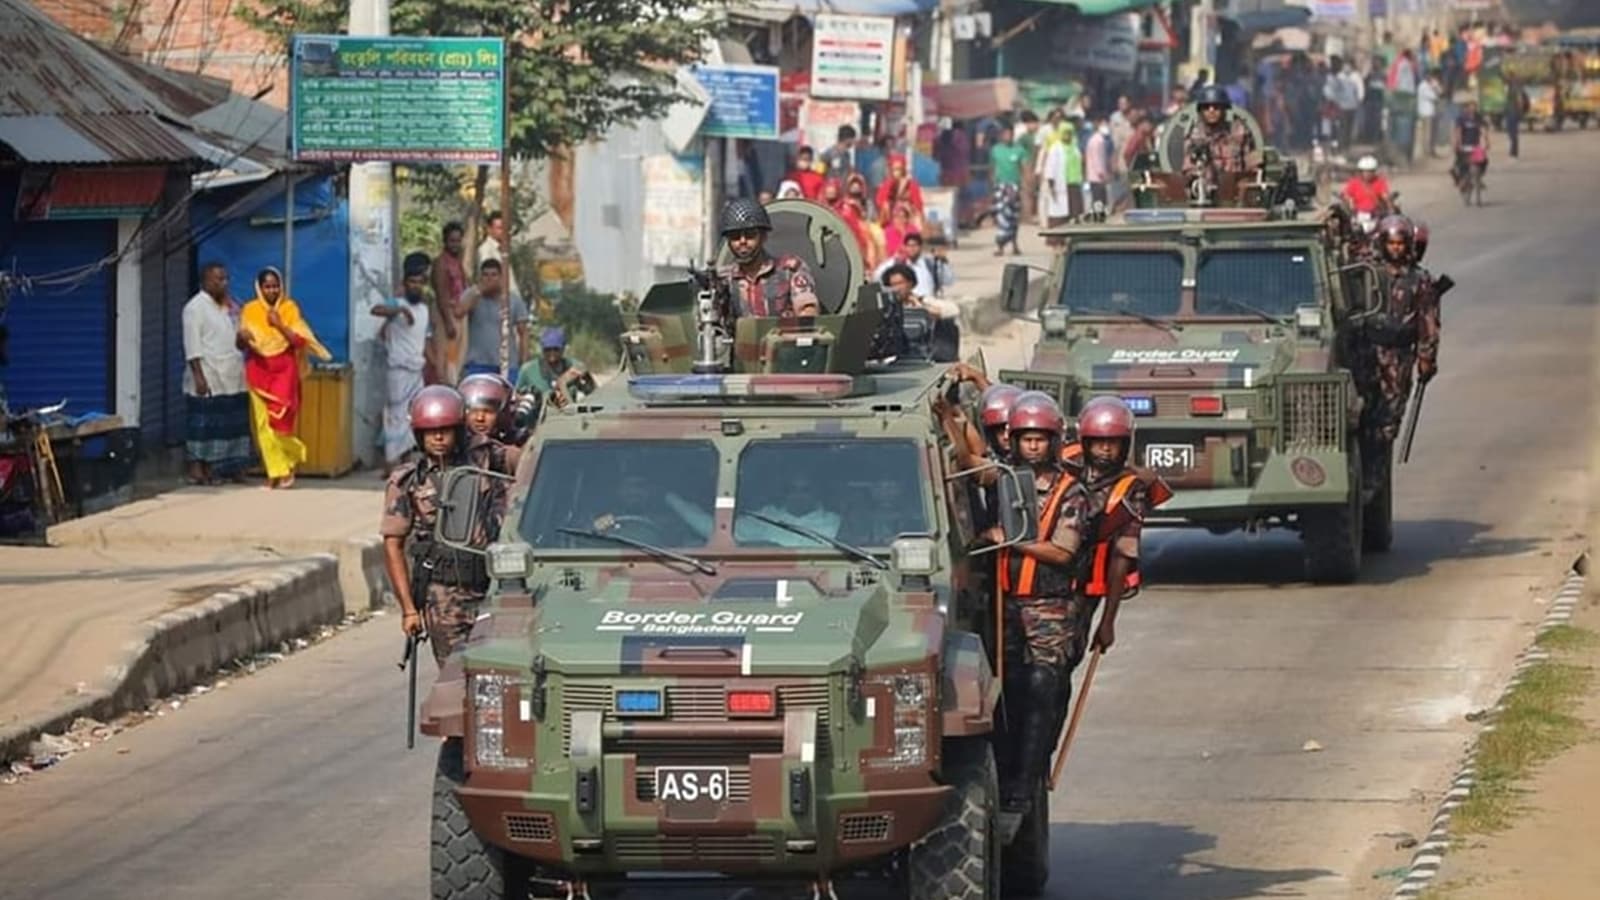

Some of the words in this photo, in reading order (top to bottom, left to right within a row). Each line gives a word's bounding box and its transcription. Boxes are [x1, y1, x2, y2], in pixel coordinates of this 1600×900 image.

[1111, 349, 1178, 359] Border
[1181, 349, 1239, 359] Guard
[1151, 448, 1188, 468] RS-1
[601, 610, 705, 625] Border
[711, 610, 803, 625] Guard
[642, 624, 747, 635] Bangladesh
[661, 772, 723, 801] AS-6
